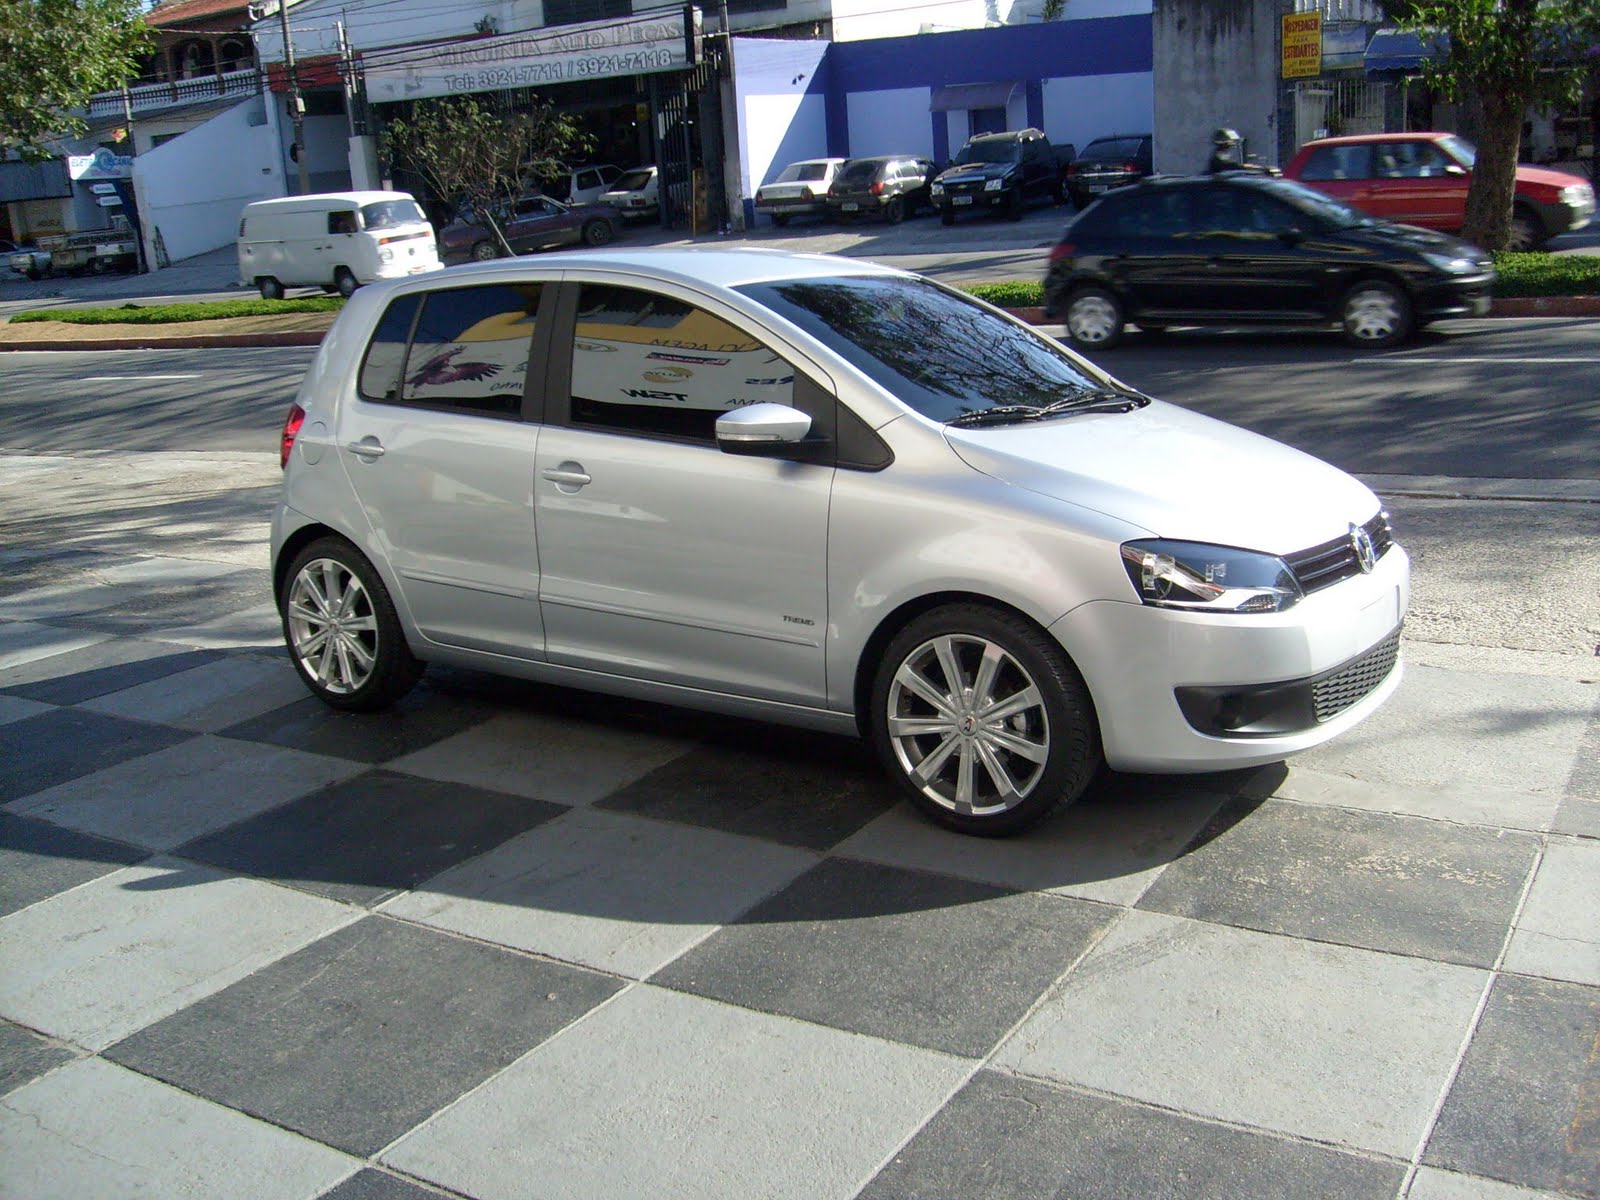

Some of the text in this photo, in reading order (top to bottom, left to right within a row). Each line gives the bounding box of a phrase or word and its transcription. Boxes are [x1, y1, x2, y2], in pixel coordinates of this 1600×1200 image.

[444, 72, 476, 91] Tel:
[478, 61, 562, 88] 3921-7711
[577, 49, 671, 76] 3921-7118
